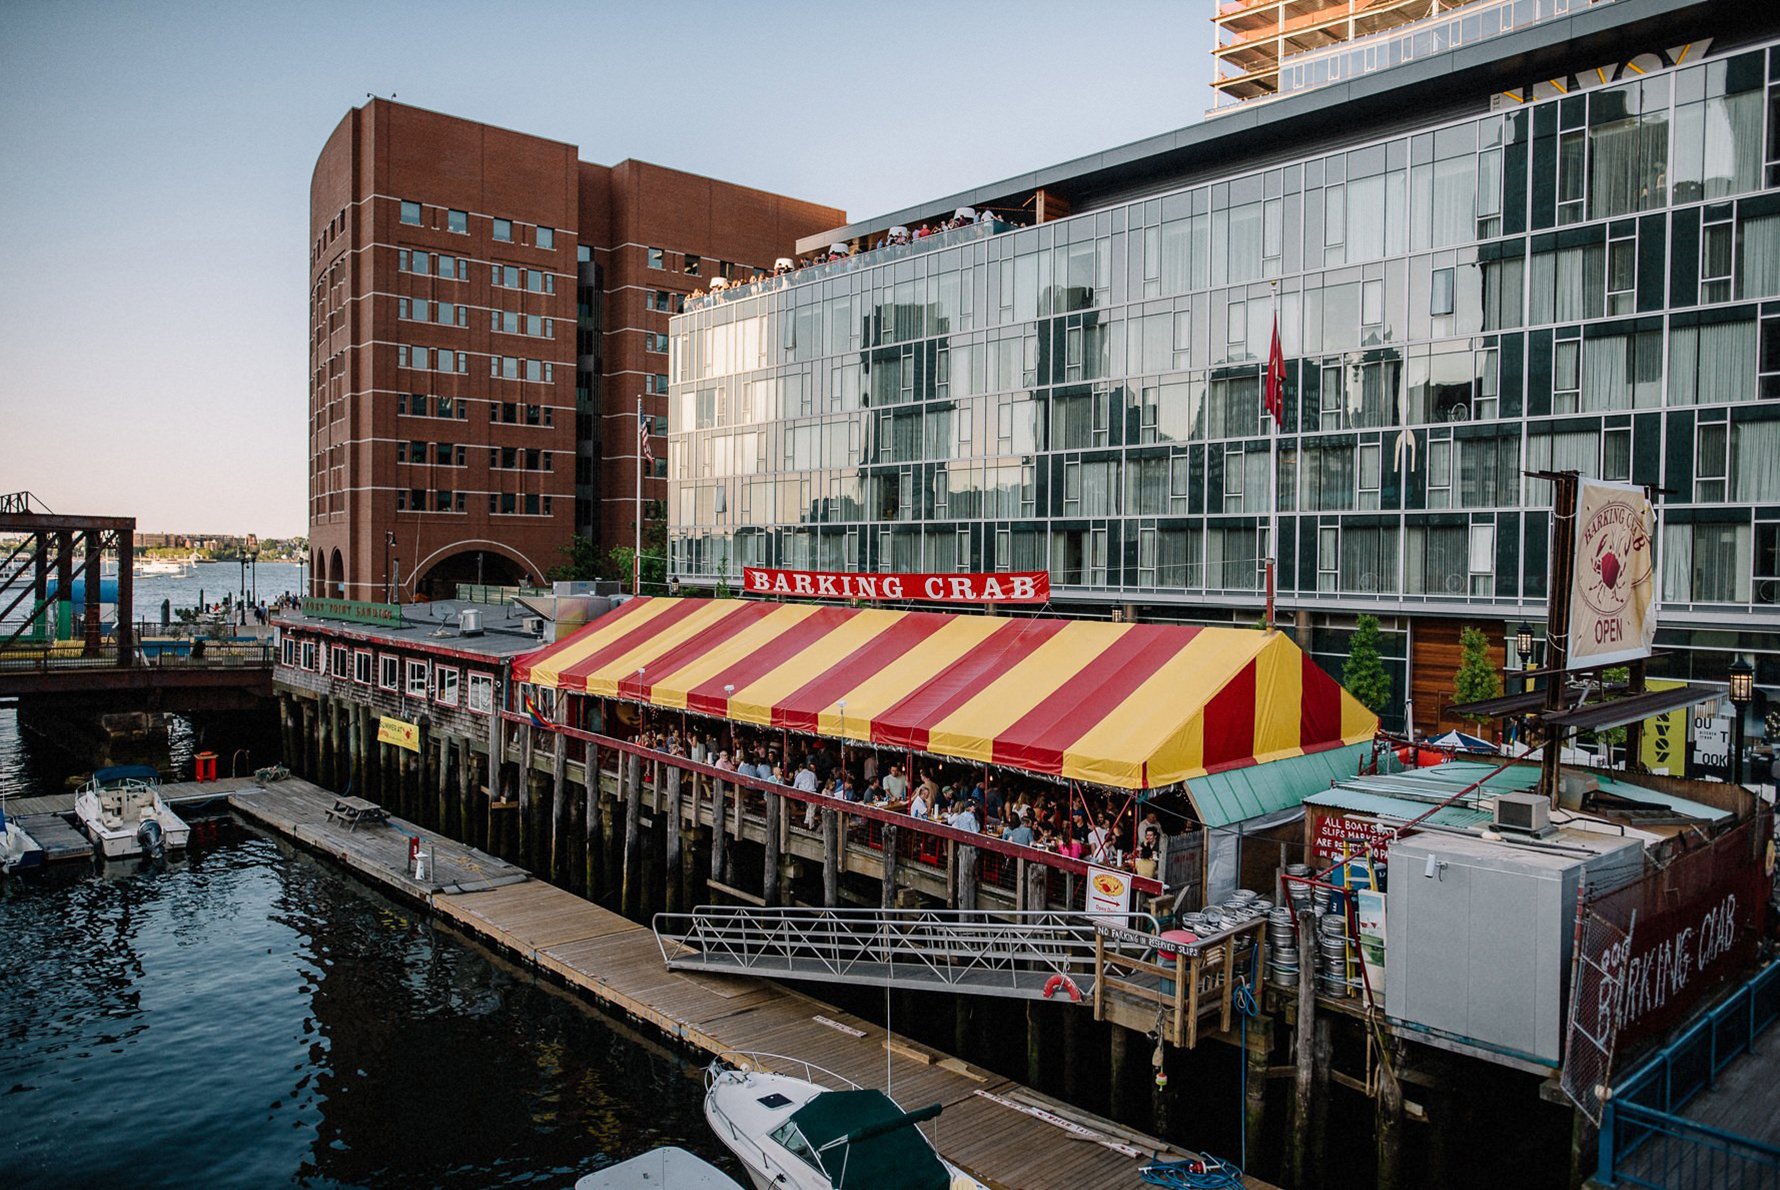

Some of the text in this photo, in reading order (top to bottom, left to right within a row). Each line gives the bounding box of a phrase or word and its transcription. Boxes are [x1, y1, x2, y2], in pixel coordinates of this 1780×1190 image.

[1584, 507, 1625, 546] BARKING
[753, 571, 1037, 600] BARKING CRAB
[1594, 618, 1623, 644] OPEN
[1655, 712, 1671, 763] NVOY
[1322, 827, 1345, 838] SLIPS
[1324, 817, 1341, 828] ALL
[1316, 838, 1332, 847] ARE
[1098, 927, 1109, 936] NO
[1111, 928, 1139, 943] PARKING
[1177, 945, 1198, 957] SLIPS
[1597, 927, 1693, 1044] BARKING
